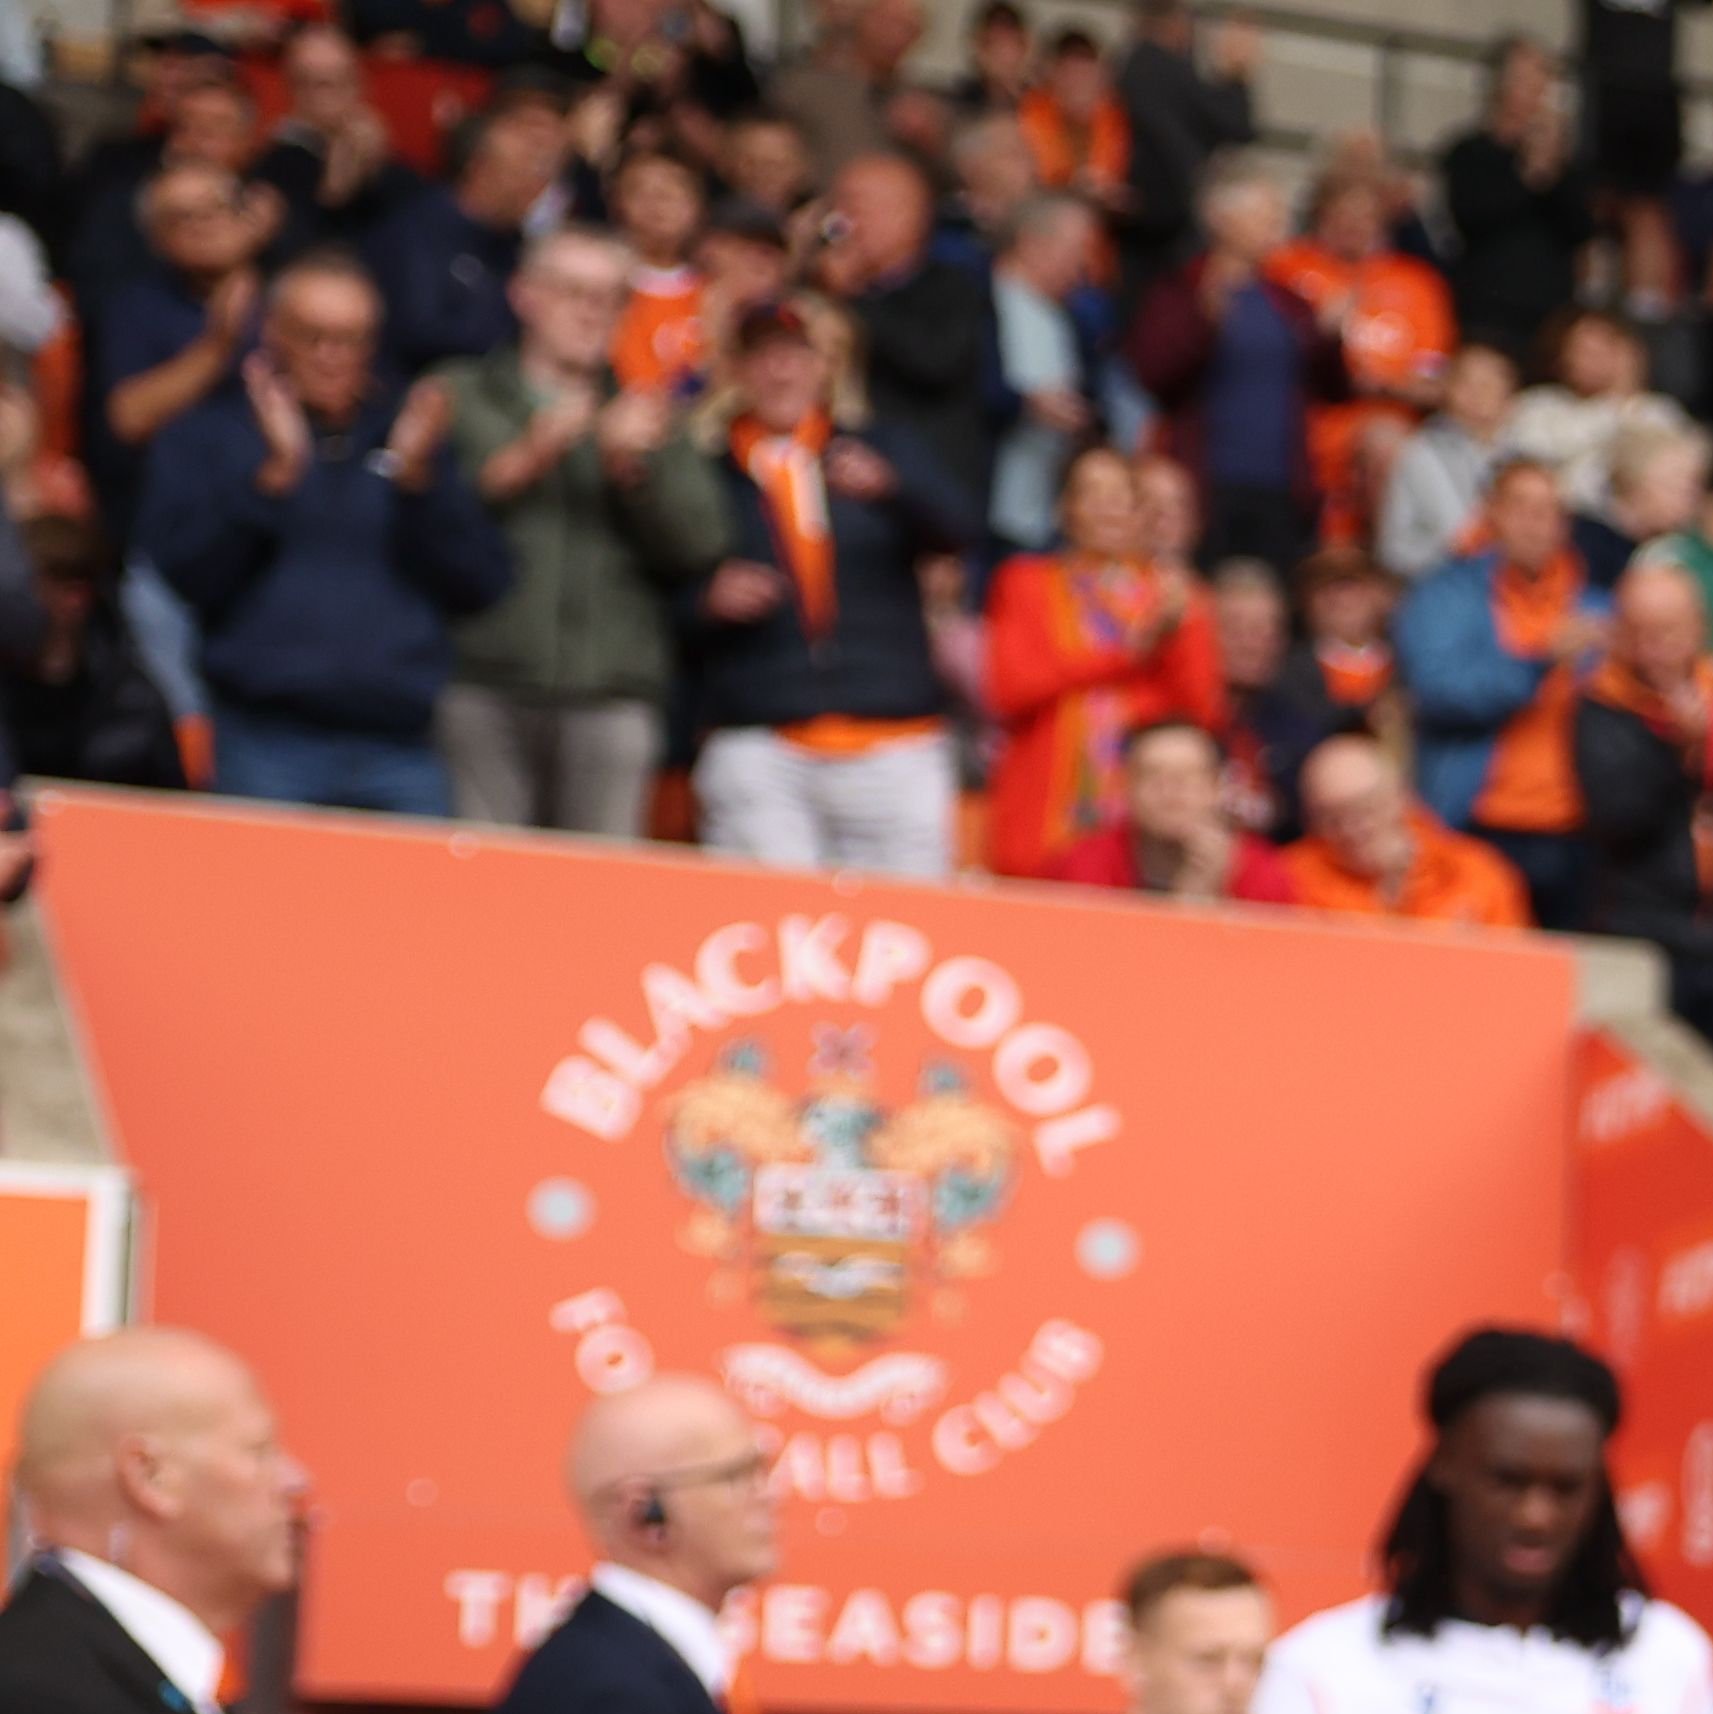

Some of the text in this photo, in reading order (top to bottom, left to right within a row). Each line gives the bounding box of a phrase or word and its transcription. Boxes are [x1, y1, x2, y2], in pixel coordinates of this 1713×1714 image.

[540, 912, 1122, 1177] BLACKPOOL
[549, 1286, 1103, 1502] FOALL CLUB
